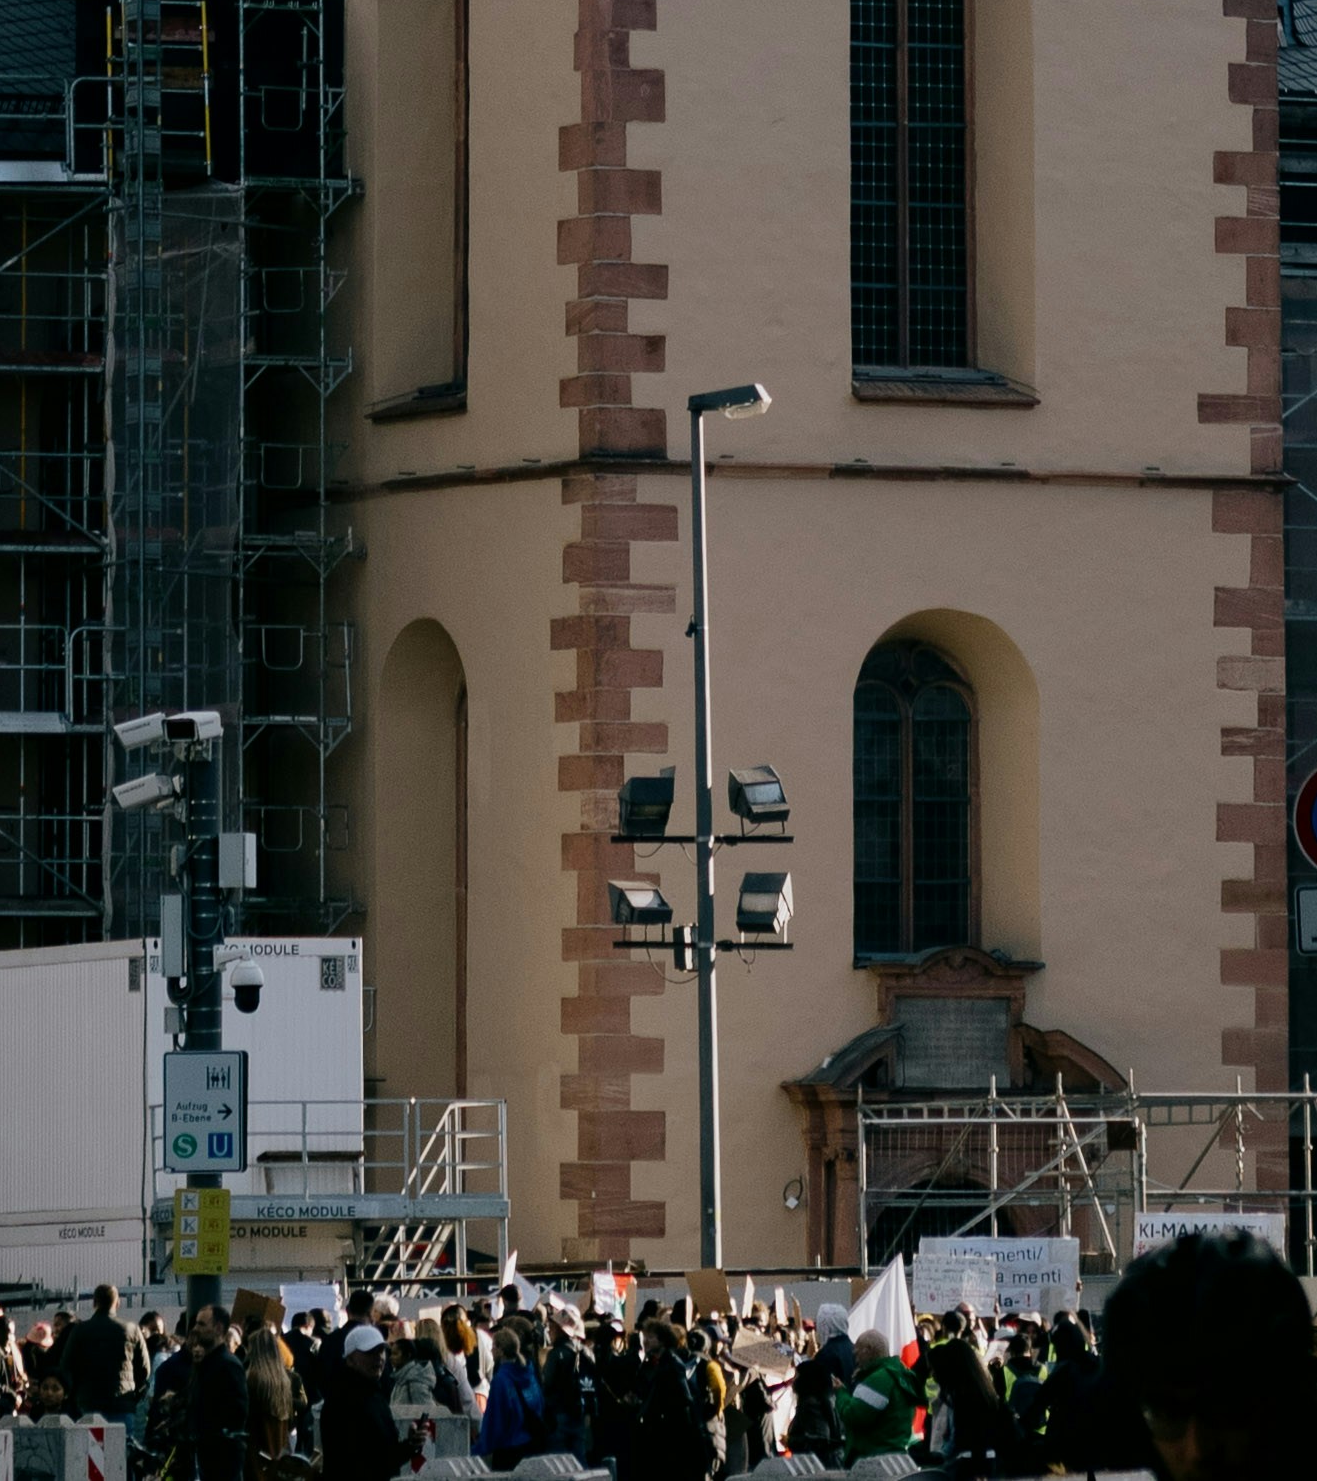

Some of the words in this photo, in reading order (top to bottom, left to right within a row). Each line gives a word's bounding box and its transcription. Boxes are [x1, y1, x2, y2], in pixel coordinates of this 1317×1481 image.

[176, 1102, 208, 1112] Aufzug
[172, 1113, 211, 1123] B-Ebene
[213, 1134, 228, 1157] U
[257, 1203, 295, 1218] KÉCO
[298, 1206, 356, 1218] MODULE
[59, 1225, 77, 1240] KÉCO
[78, 1226, 106, 1238] MODULE
[251, 1226, 307, 1238] MODULE
